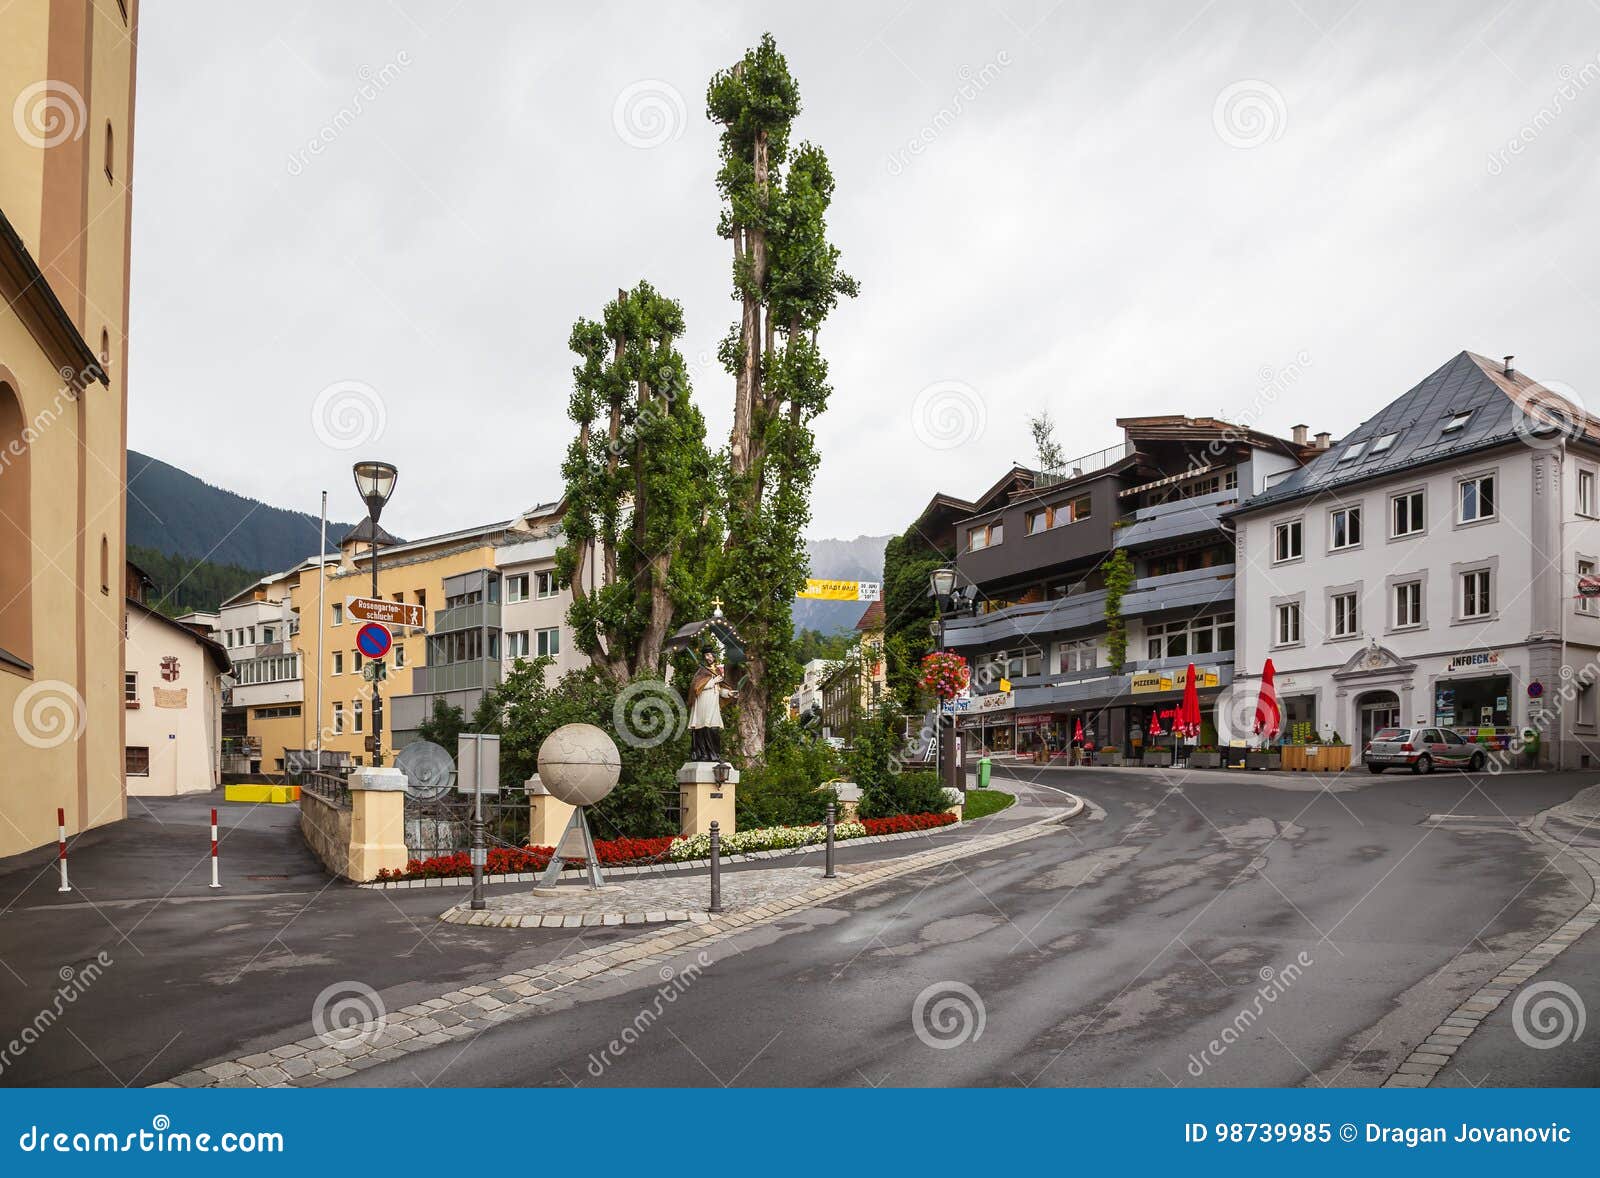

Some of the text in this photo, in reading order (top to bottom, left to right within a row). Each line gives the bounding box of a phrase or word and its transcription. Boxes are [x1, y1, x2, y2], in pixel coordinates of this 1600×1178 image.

[358, 600, 400, 613] Rosengarten-
[366, 611, 394, 621] schlucht
[1133, 678, 1160, 687] PIZZERIA
